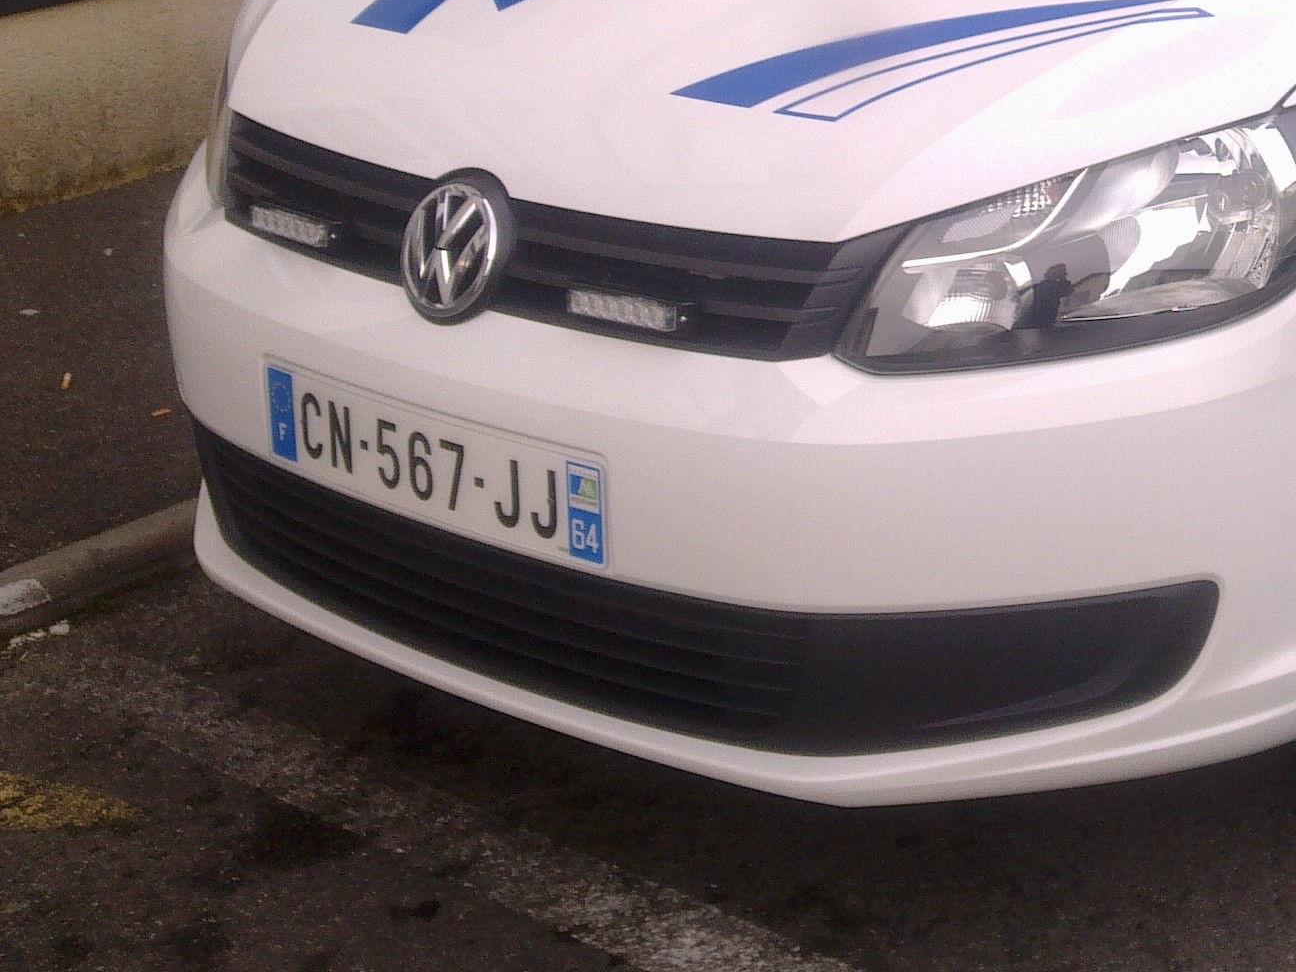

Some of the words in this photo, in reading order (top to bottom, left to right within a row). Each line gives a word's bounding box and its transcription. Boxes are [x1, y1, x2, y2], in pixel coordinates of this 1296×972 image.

[278, 422, 287, 441] F
[300, 392, 558, 540] CN-567-JJ
[571, 518, 599, 554] 64
